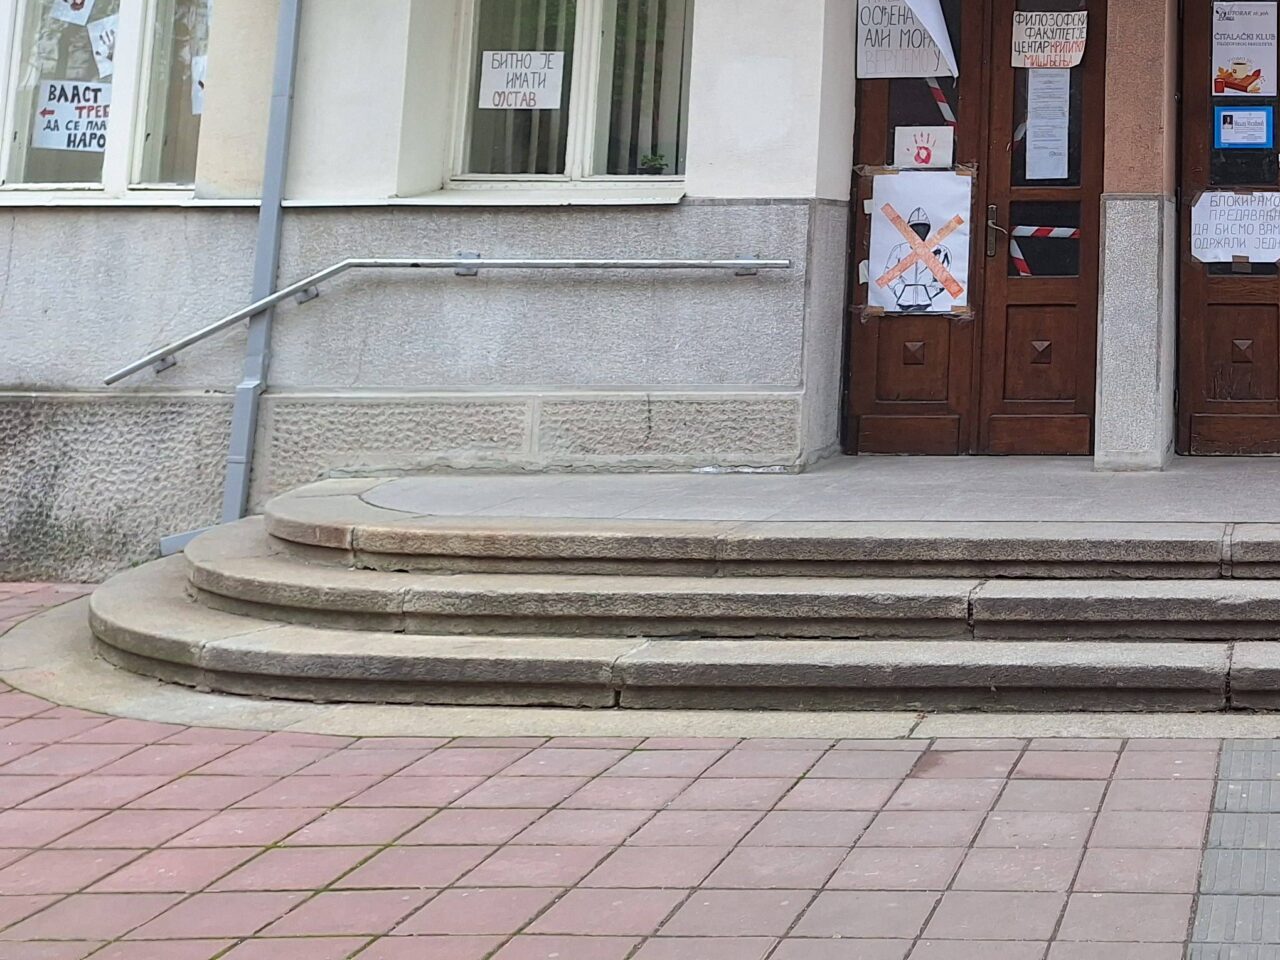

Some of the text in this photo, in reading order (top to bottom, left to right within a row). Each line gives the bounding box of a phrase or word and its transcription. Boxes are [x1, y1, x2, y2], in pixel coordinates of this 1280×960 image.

[864, 28, 891, 48] АЛИ
[1025, 27, 1075, 40] ФАКУЛТЕТ
[1214, 32, 1254, 40] ČITALAČKI
[1014, 41, 1049, 56] ЦЕНТАР
[491, 53, 555, 70] БИТНО ЈЕ
[505, 72, 547, 89] ИМАТИ
[48, 84, 102, 104] ВЛАСТ
[43, 119, 60, 132] ДА
[65, 120, 81, 131] СЕ
[1210, 195, 1280, 207] БЛОКИРАМО
[1193, 224, 1209, 235] ДА
[1194, 238, 1247, 250] ОДРЖАЛИ
